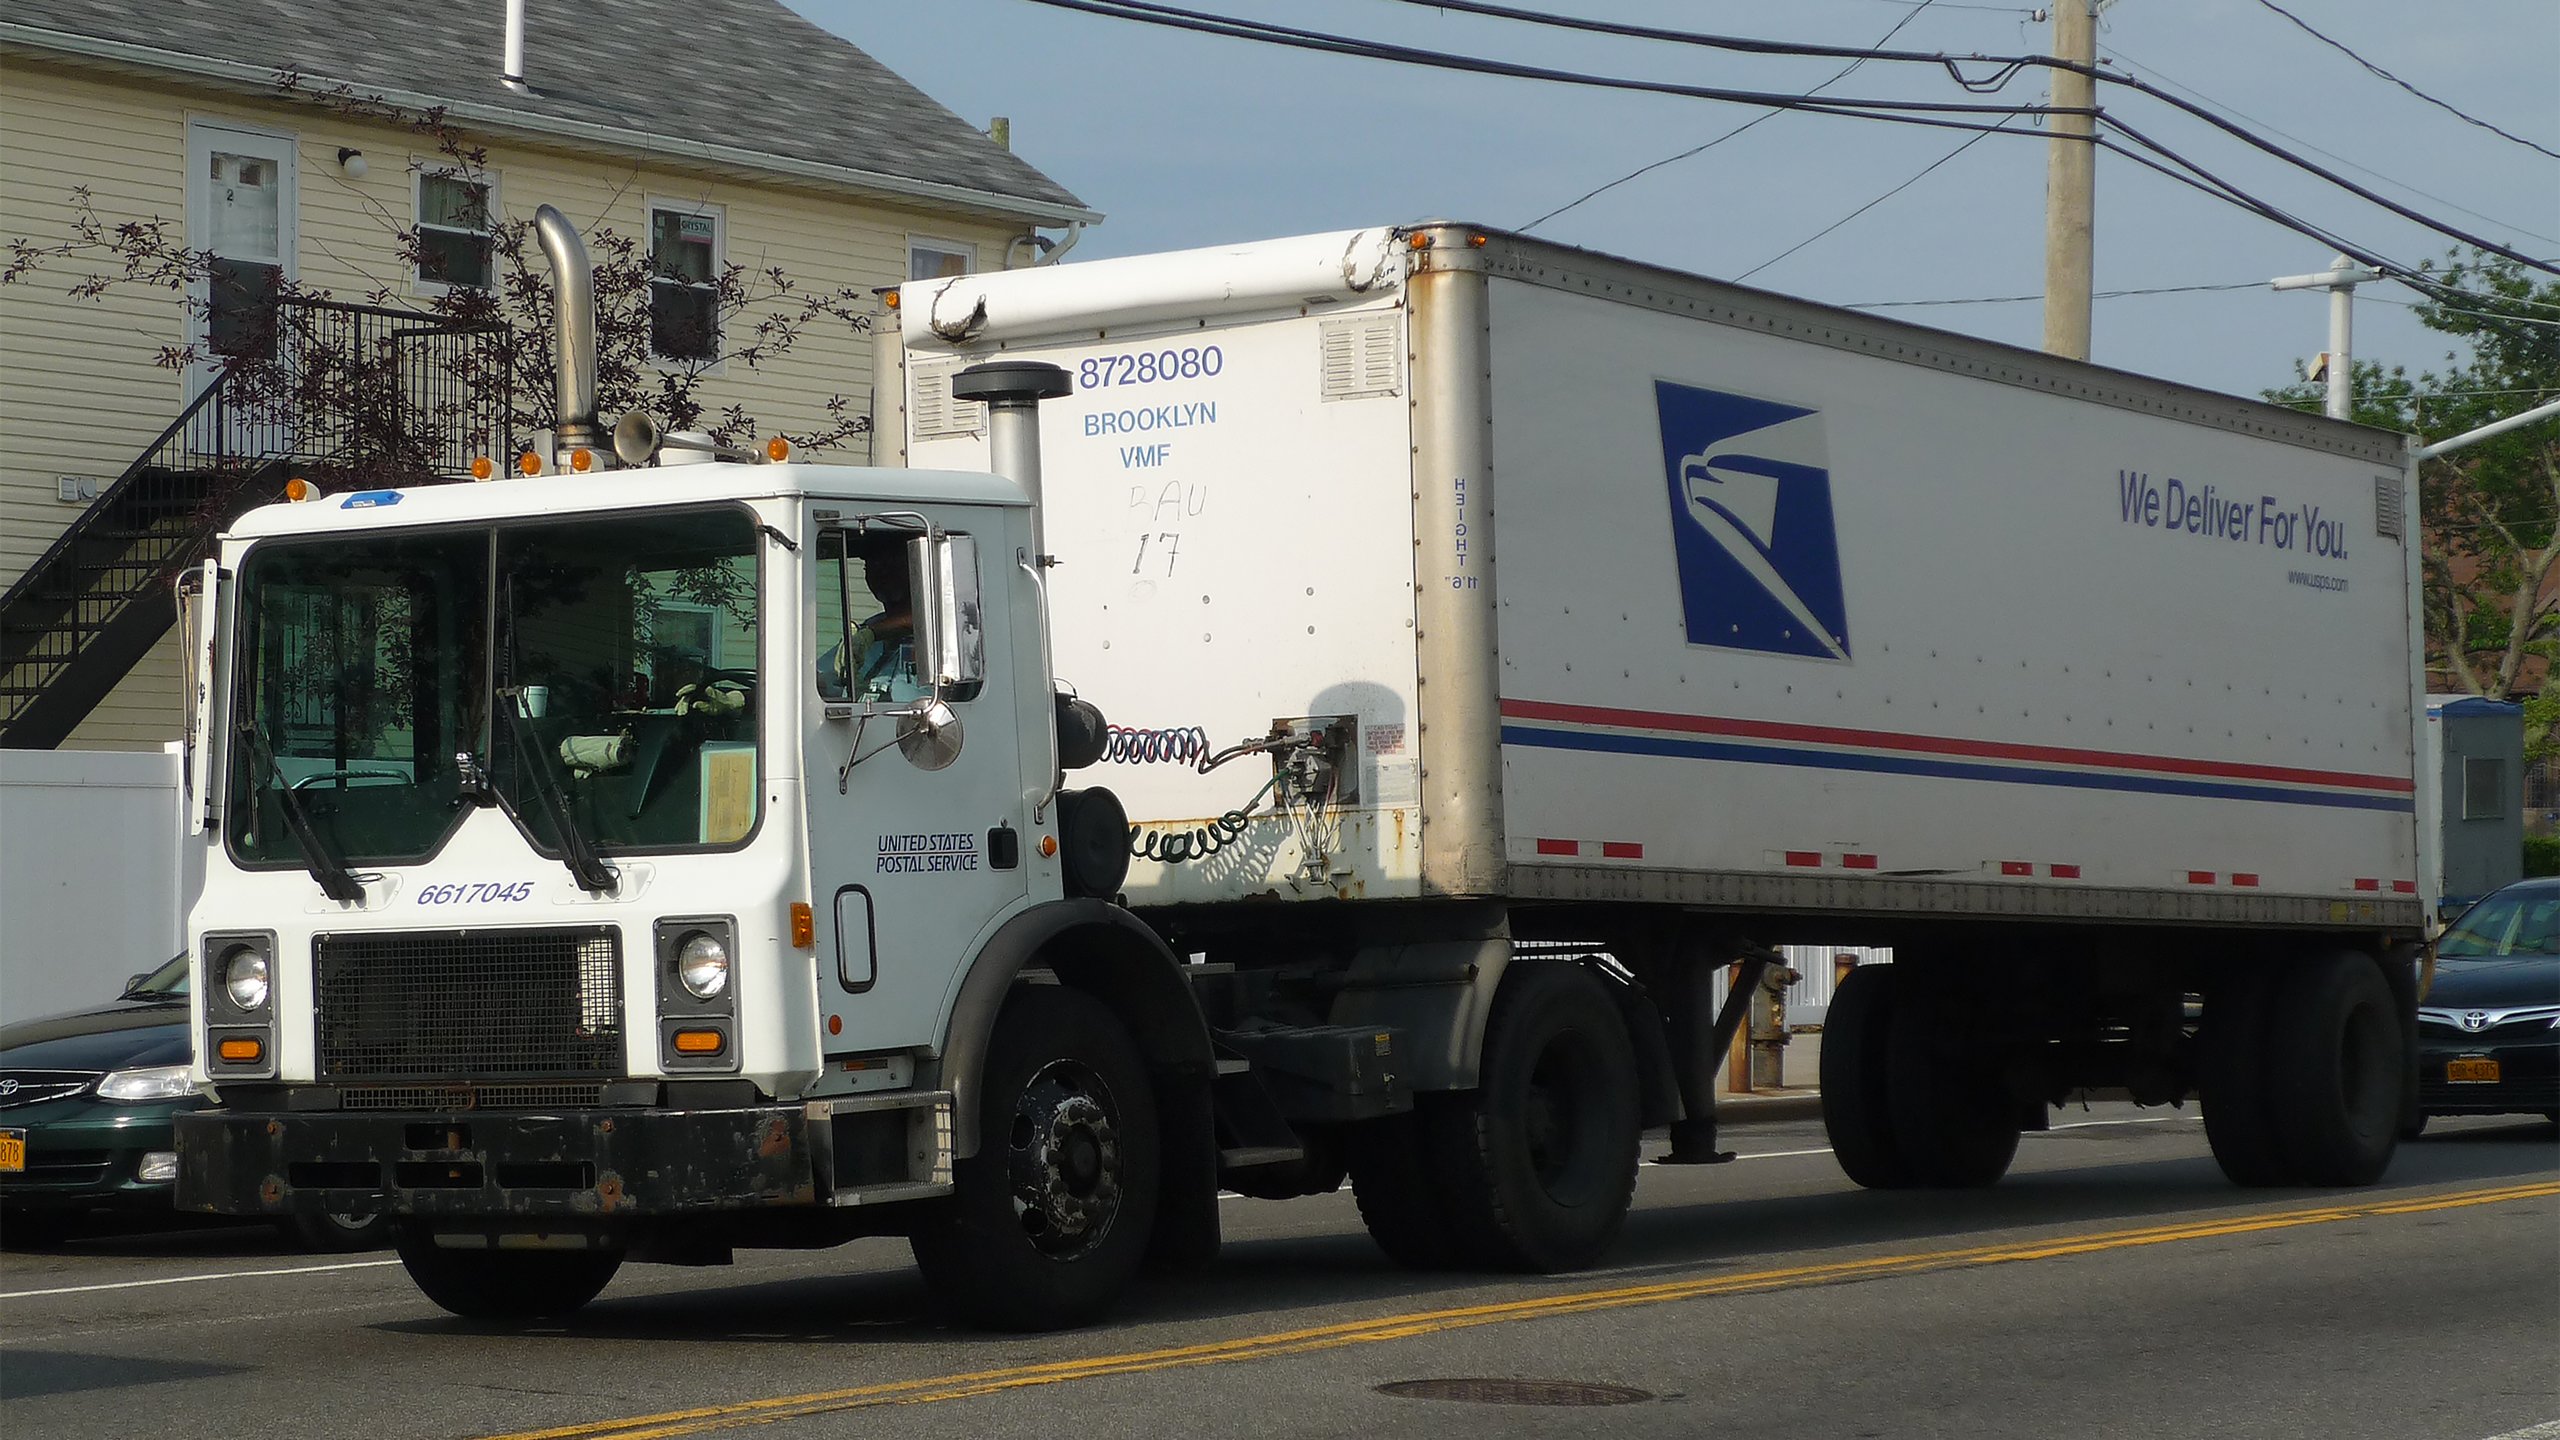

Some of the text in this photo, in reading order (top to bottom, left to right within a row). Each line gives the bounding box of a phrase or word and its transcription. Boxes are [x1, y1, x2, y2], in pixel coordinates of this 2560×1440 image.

[226, 188, 234, 201] 2
[1079, 345, 1223, 390] 8728080
[1084, 401, 1217, 437] BROOKLYN
[1119, 443, 1172, 469] VMF
[2119, 469, 2348, 561] We Deliver For You.
[1132, 532, 1180, 578] 17
[2287, 570, 2349, 592] www.usps.com
[878, 833, 974, 852] UNITED STATES
[876, 854, 978, 873] POSTAL SERVICE
[417, 881, 535, 905] 6617045
